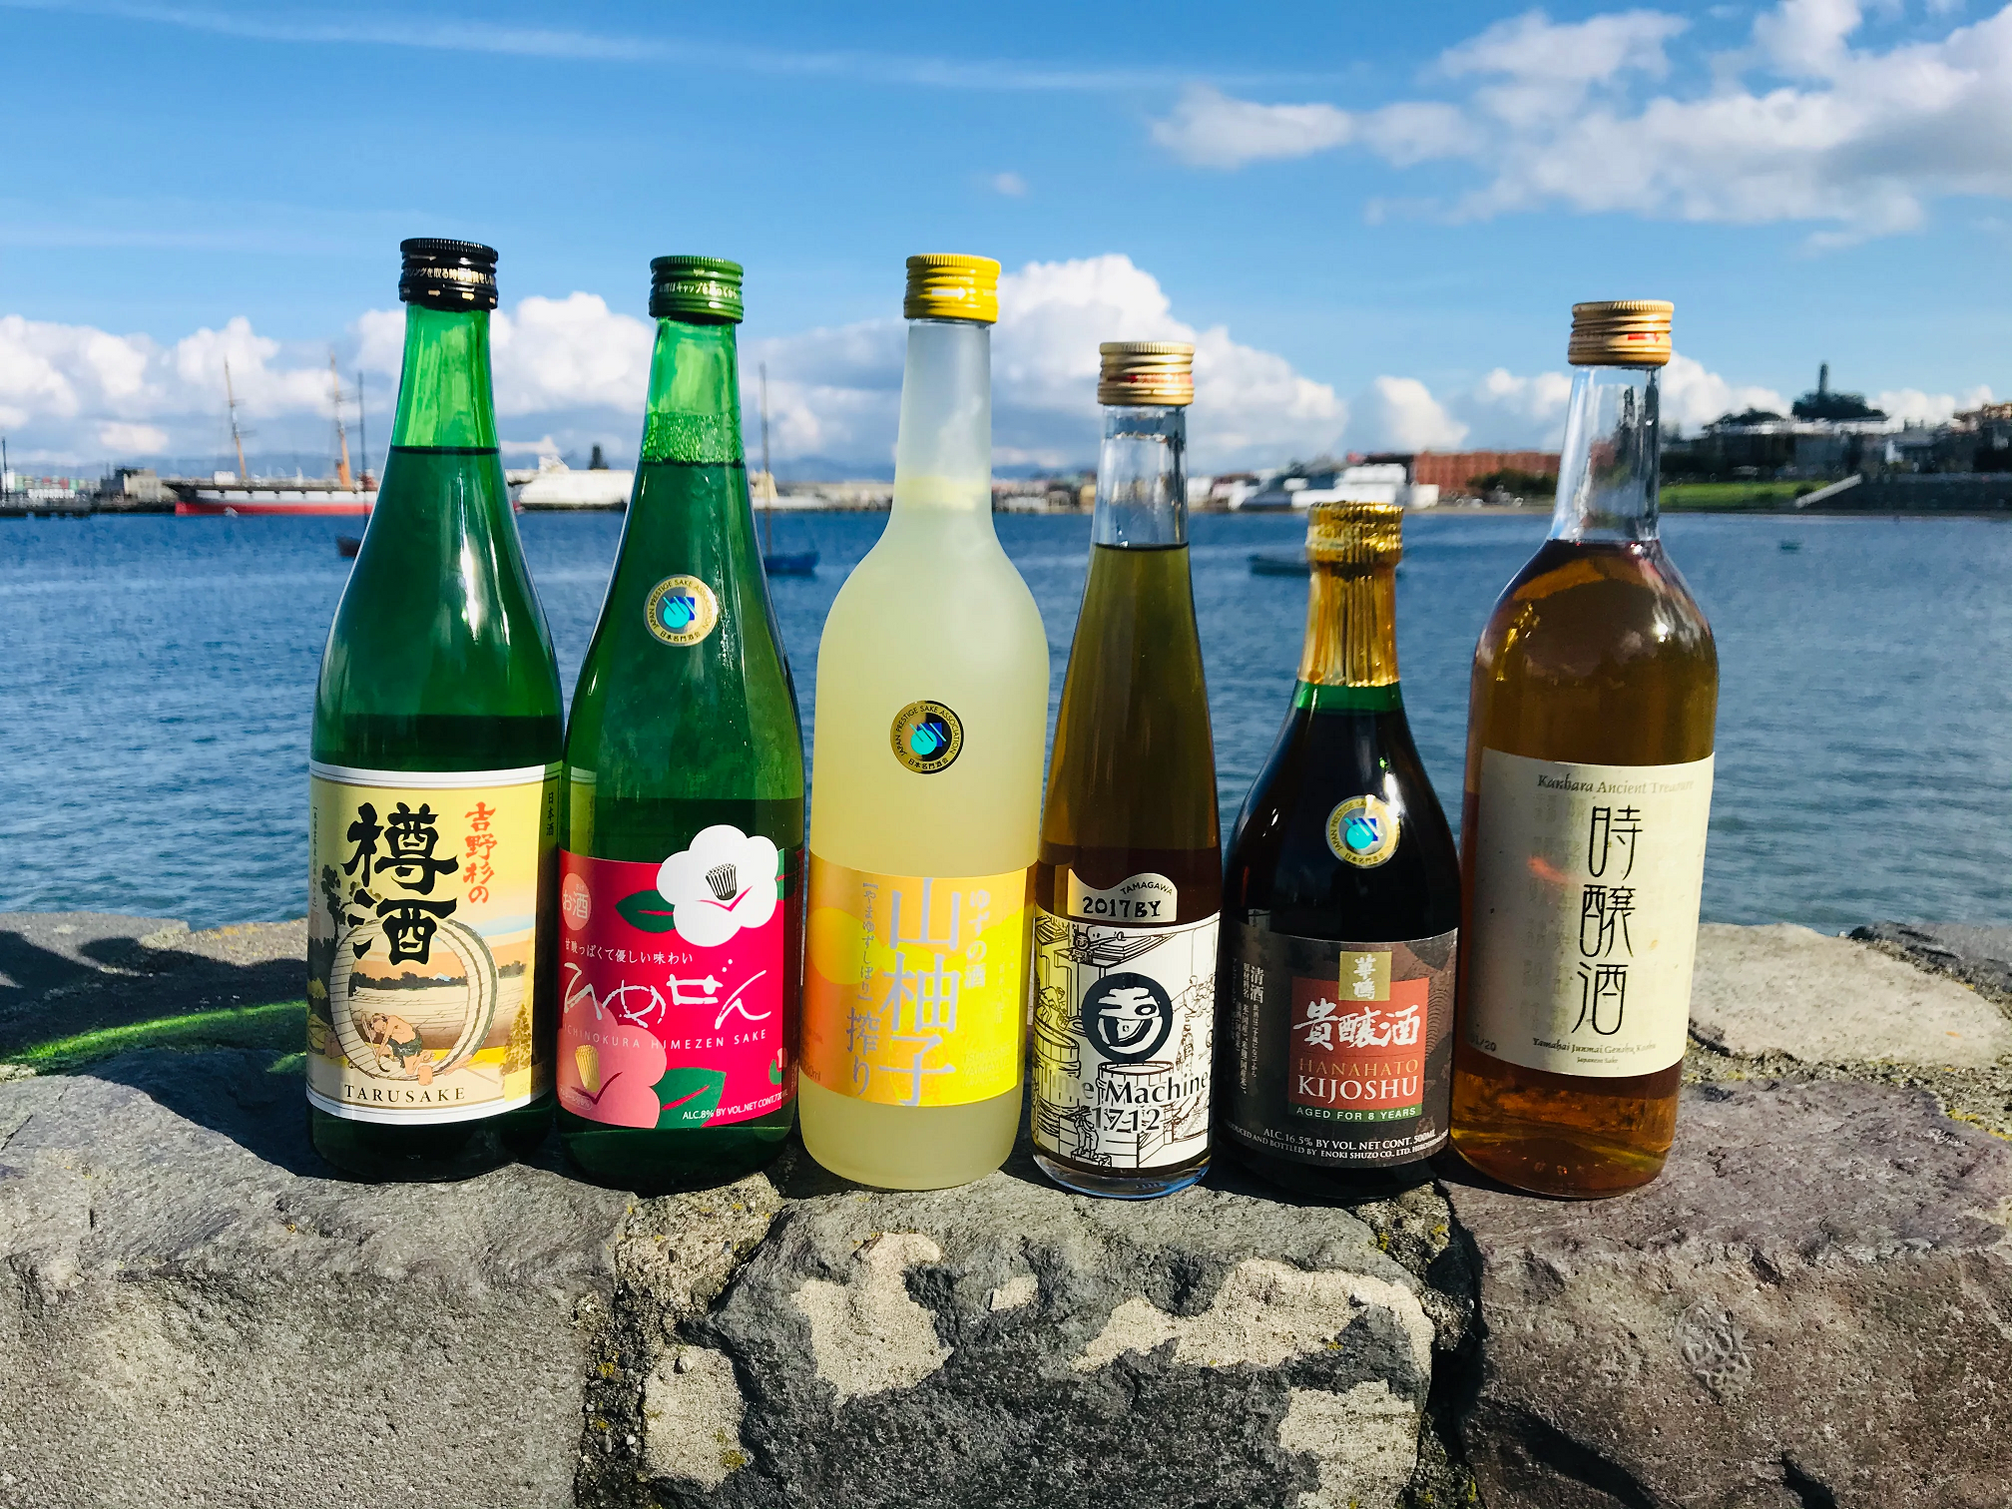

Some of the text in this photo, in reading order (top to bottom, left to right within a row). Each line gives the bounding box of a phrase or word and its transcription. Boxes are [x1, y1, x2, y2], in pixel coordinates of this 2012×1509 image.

[674, 579, 693, 587] SAKE
[894, 704, 960, 757] JAPAN PRESTIGE SAKE ASSOCIATION
[1596, 780, 1648, 794] Ancient
[546, 791, 555, 836] 日本酒
[462, 801, 498, 904] 吉野杉の
[341, 801, 459, 966] 樽酒
[1119, 881, 1173, 897] TAMAGAWA
[562, 890, 589, 920] お酒
[964, 889, 991, 990] ゆずの酒
[1250, 964, 1265, 1004] 清酒
[734, 1029, 768, 1046] SAKE
[1571, 1044, 1603, 1054] Junmai
[1299, 1057, 1419, 1077] HANAHATO
[344, 1084, 466, 1103] TARUSAKE
[1105, 1070, 1209, 1106] Machine
[1297, 1075, 1419, 1103] KIJOSHU
[715, 1106, 727, 1117] BY
[1091, 1105, 1162, 1133] 1712
[1296, 1106, 1416, 1121] AGED FOR 8 YEARS
[1252, 1134, 1269, 1145] AND
[1269, 1139, 1305, 1154] BOTTLED
[1306, 1148, 1317, 1156] BY
[1320, 1149, 1347, 1159] ENOKI
[1349, 1150, 1379, 1159] SHUZO
[1315, 1139, 1330, 1149] BY
[1359, 1140, 1381, 1151] NET
[1382, 1136, 1413, 1150] CONT.
